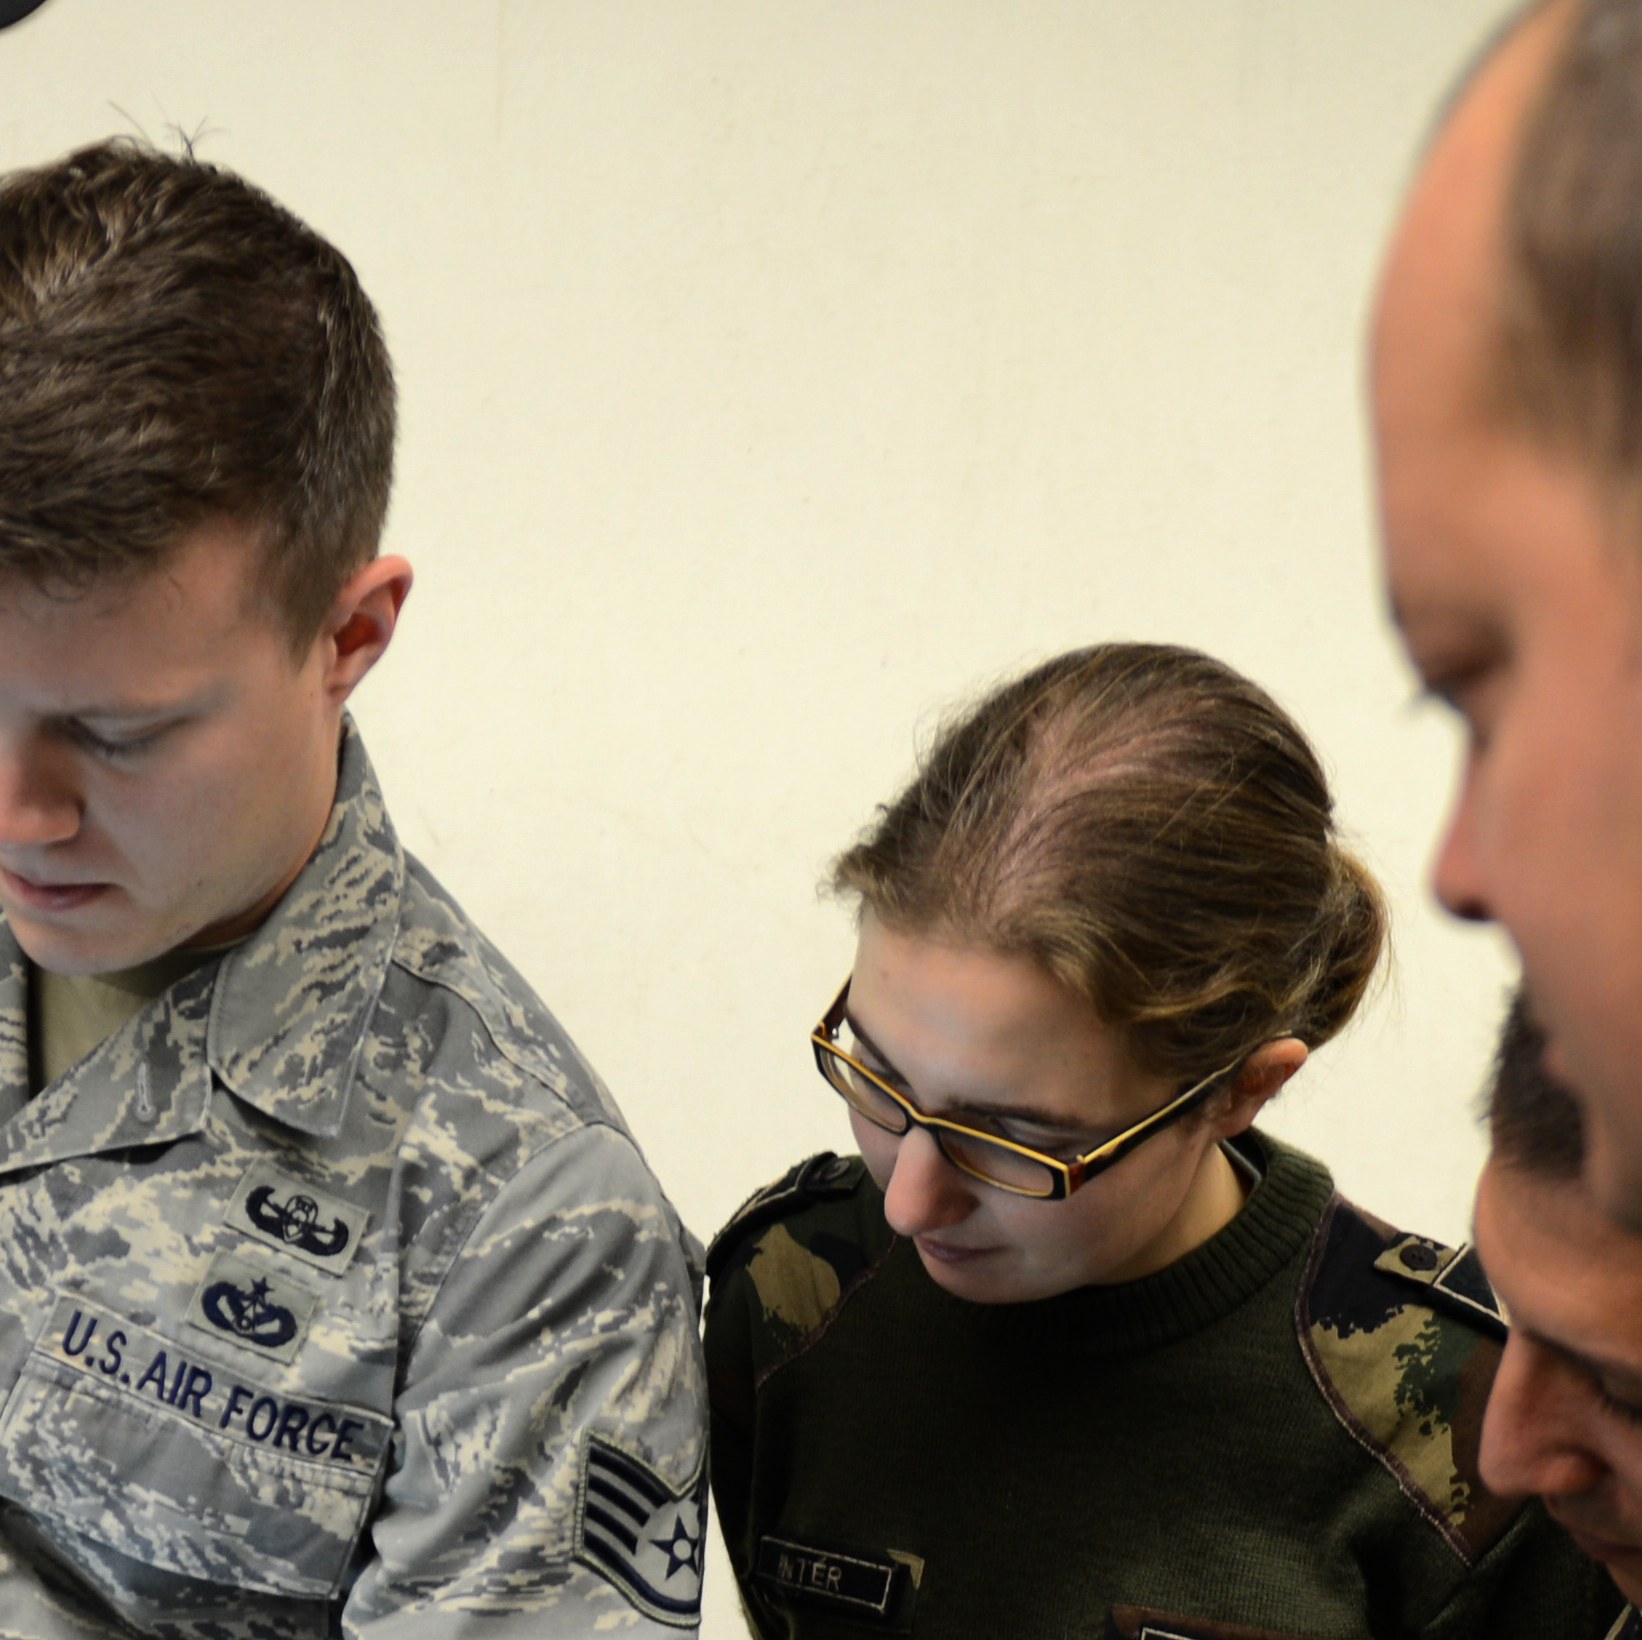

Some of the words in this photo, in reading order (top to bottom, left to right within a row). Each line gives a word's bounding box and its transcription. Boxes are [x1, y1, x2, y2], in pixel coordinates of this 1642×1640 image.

[61, 1310, 131, 1385] U.S.
[136, 1350, 213, 1418] AIR
[219, 1384, 365, 1463] FORCE
